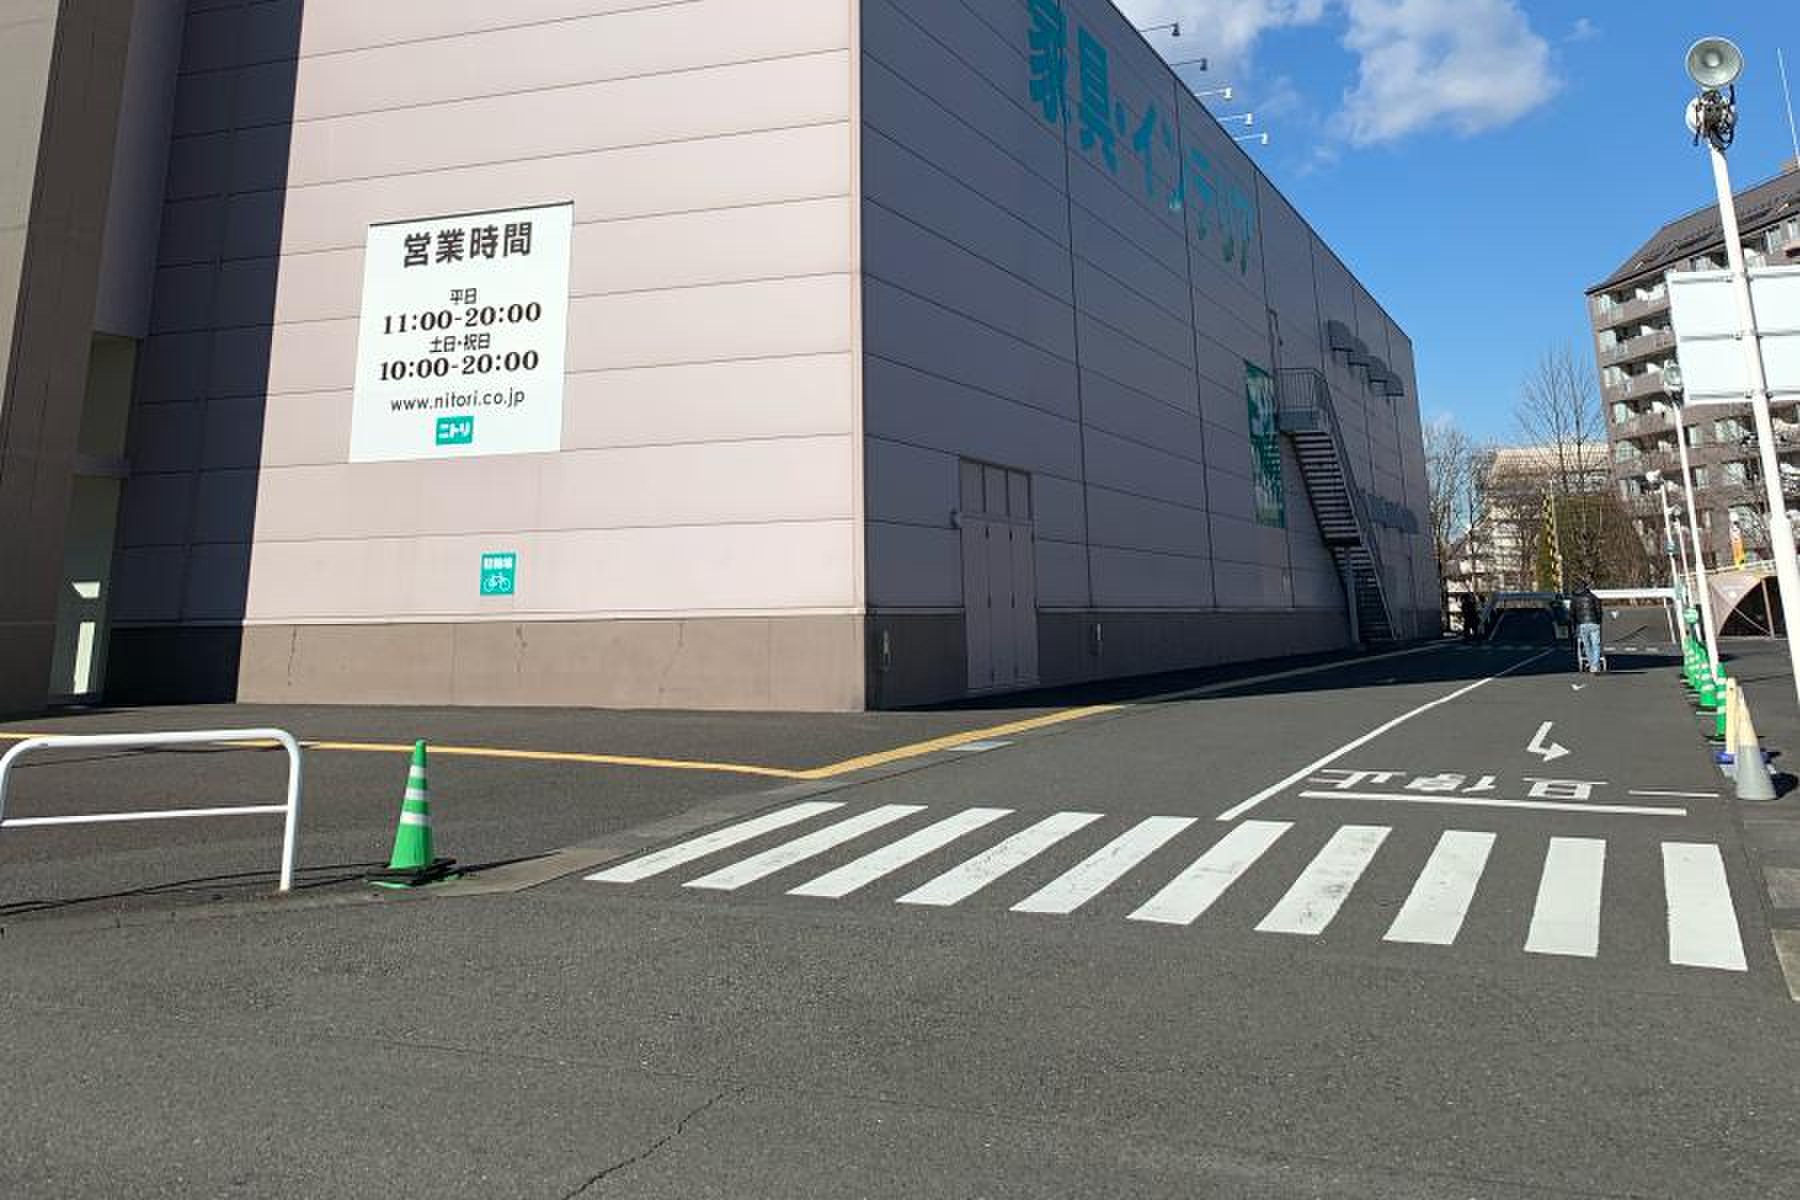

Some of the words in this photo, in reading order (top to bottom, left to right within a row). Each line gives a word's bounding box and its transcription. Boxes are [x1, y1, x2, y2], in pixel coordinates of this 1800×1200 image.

[403, 222, 532, 268] 営業時間
[450, 288, 477, 305] 平日
[383, 302, 542, 335] 11:00-20:00
[380, 350, 539, 381] 10:00-20:00
[391, 388, 525, 412] www.nitori.co.jp
[438, 420, 471, 440] ニトリ
